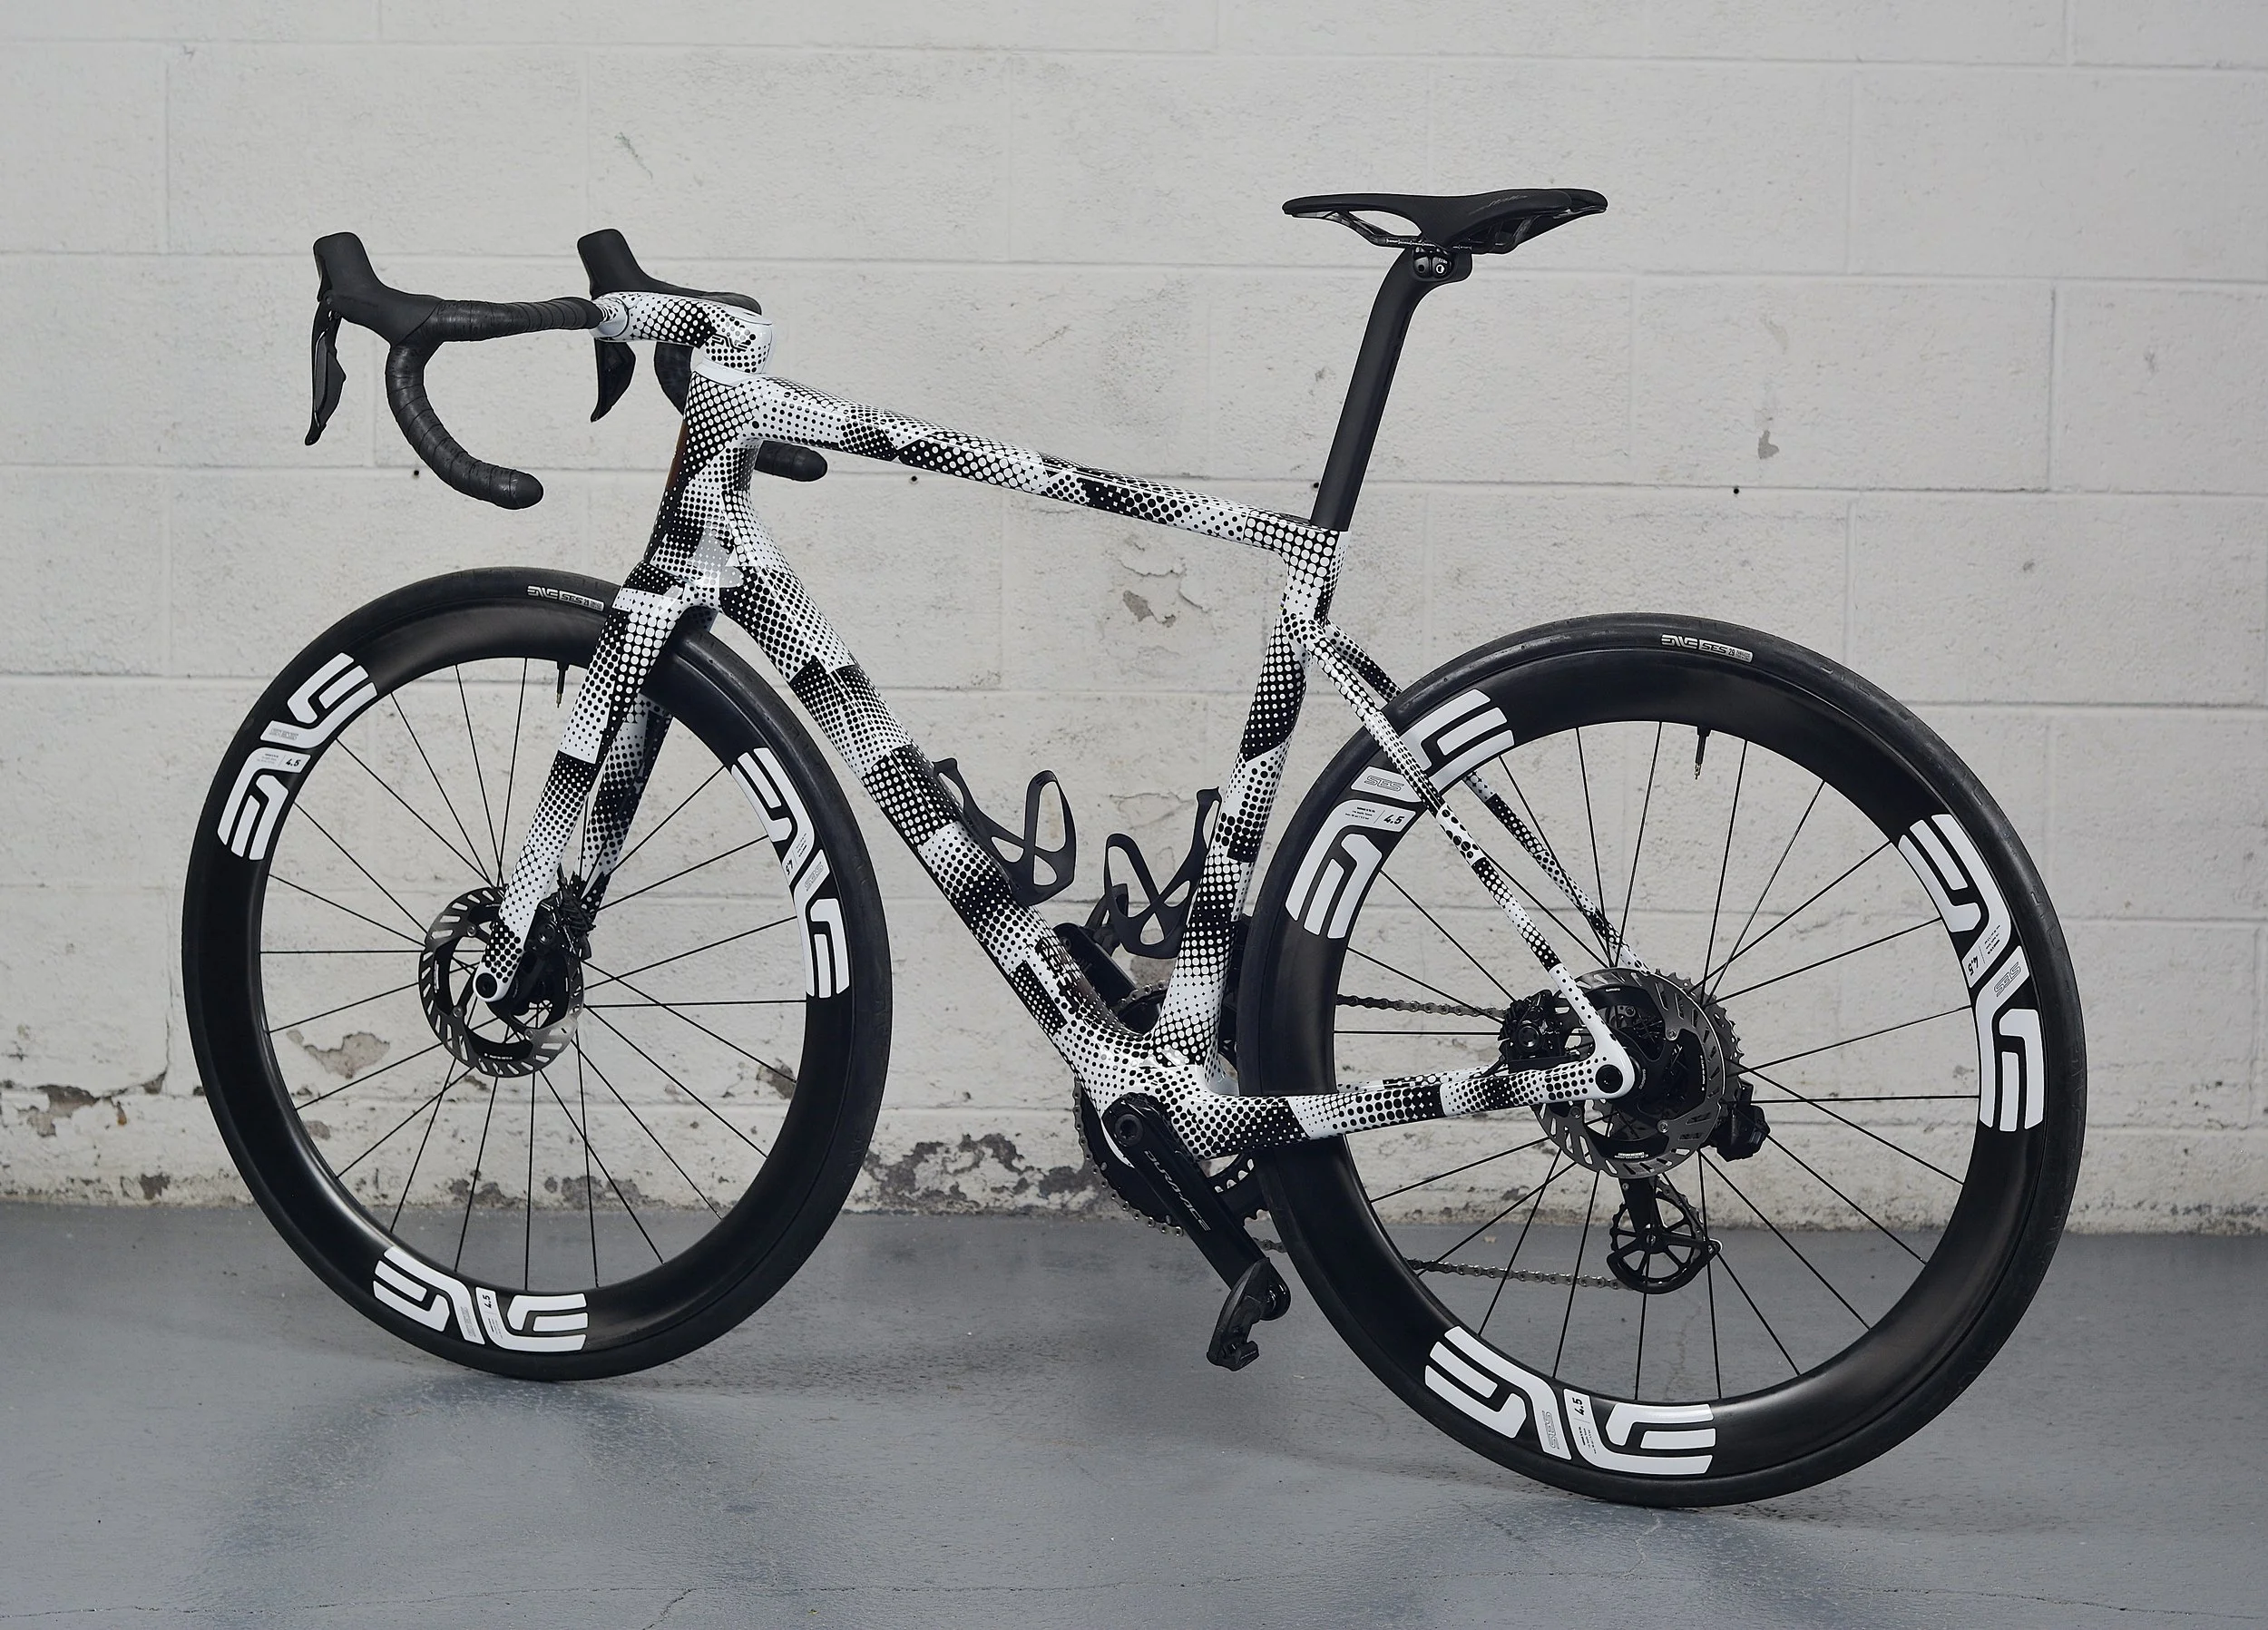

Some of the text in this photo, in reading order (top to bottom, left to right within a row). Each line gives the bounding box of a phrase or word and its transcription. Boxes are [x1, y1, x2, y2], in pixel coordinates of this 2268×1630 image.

[1661, 634, 1698, 649] ENVE
[1702, 642, 1728, 654] SES
[1728, 648, 1735, 657] 29
[218, 652, 377, 861] ENVE
[285, 757, 302, 767] 4.5
[1364, 775, 1405, 792] SES
[1383, 814, 1405, 825] 4.5
[730, 747, 850, 999] ENVE
[1898, 814, 2045, 1132] ENVE
[1968, 955, 1980, 977] 4.5
[1993, 961, 2022, 998] SES
[1144, 1150, 1211, 1232] DURA-ACE
[373, 1245, 589, 1352] ENVE
[482, 1293, 493, 1309] 4.5
[1424, 1325, 1716, 1476] ENVE
[1571, 1397, 1585, 1416] 4.5
